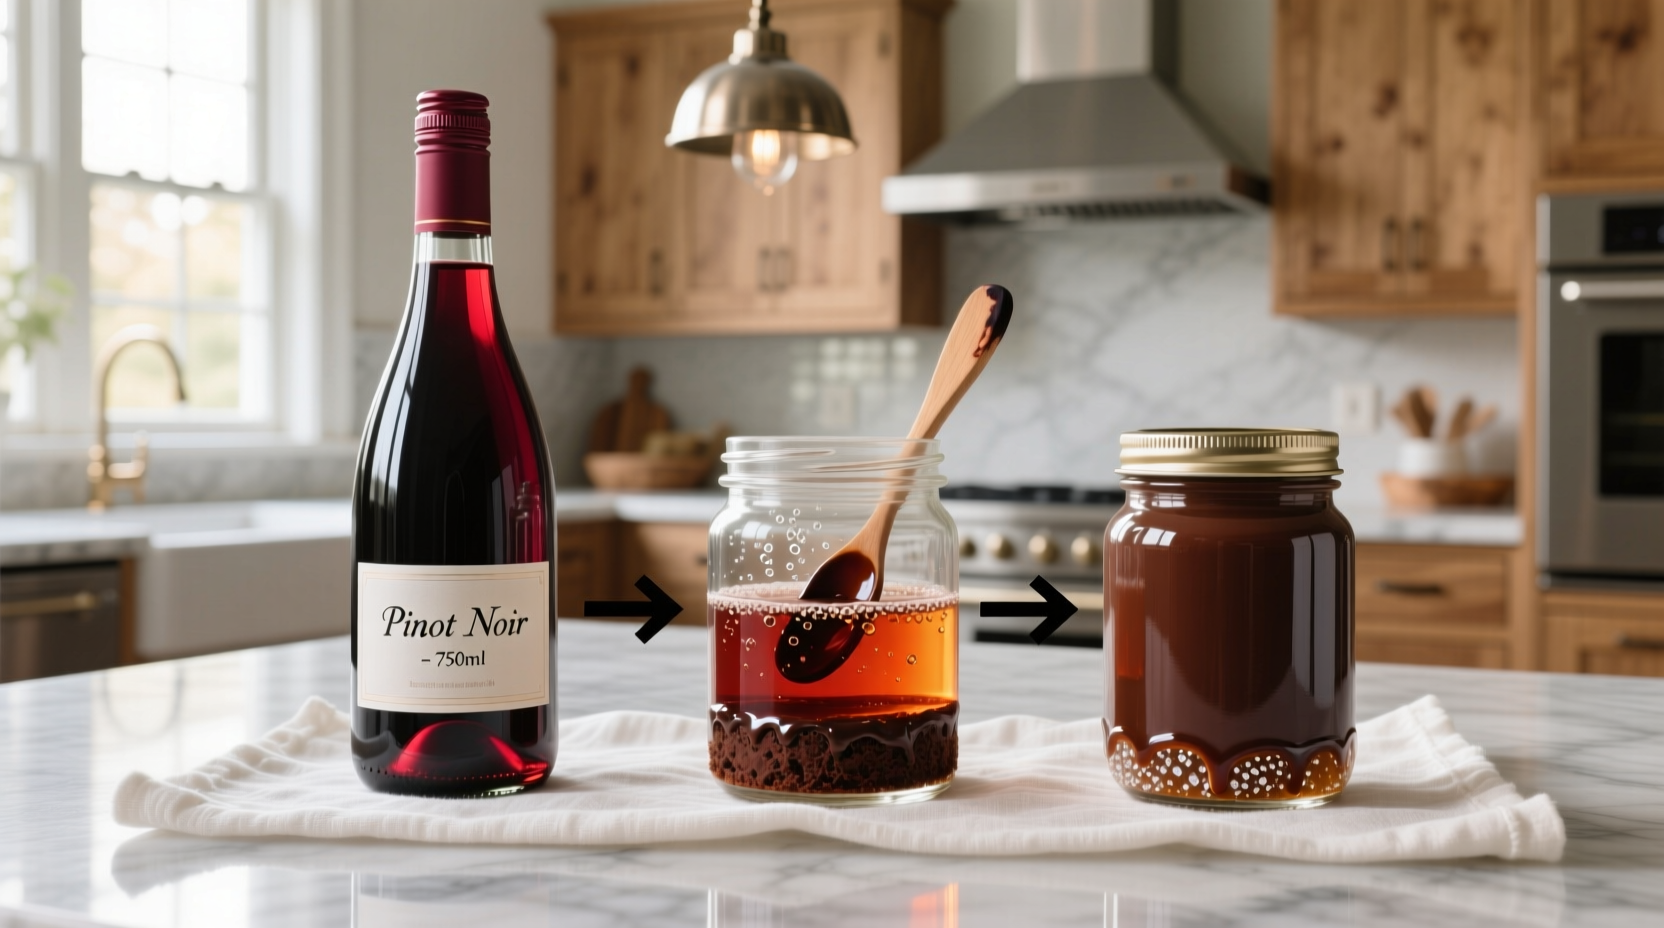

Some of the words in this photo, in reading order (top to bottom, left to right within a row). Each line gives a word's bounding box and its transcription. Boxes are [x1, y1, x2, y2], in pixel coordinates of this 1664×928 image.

[382, 605, 457, 638] Pinot
[463, 605, 529, 638] Noir
[435, 650, 486, 668] 750ml
